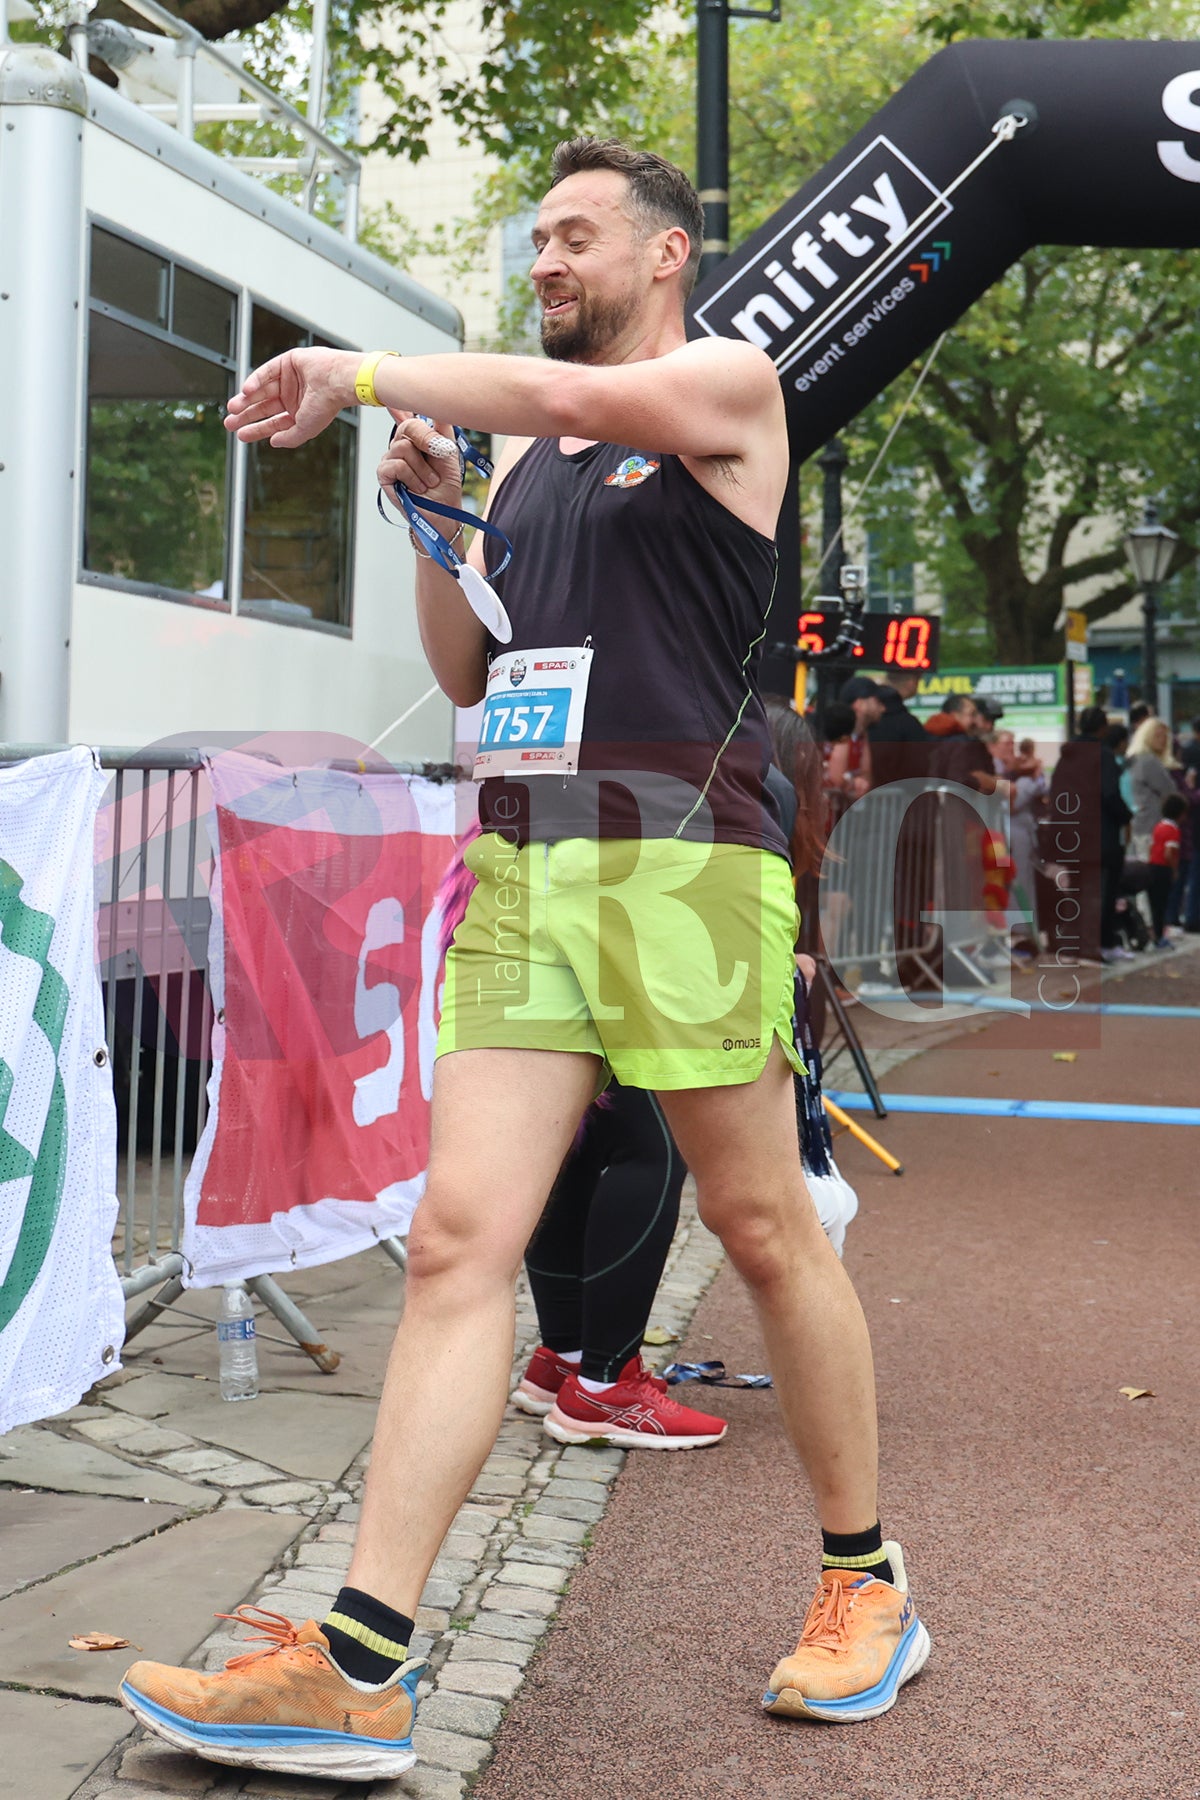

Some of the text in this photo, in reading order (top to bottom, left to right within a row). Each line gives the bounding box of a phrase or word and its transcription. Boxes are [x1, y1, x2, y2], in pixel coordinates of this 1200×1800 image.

[731, 172, 908, 351] nifty
[794, 276, 916, 392] event services
[542, 661, 568, 670] SPAR
[480, 705, 554, 745] 1757
[529, 751, 556, 761] SPAR
